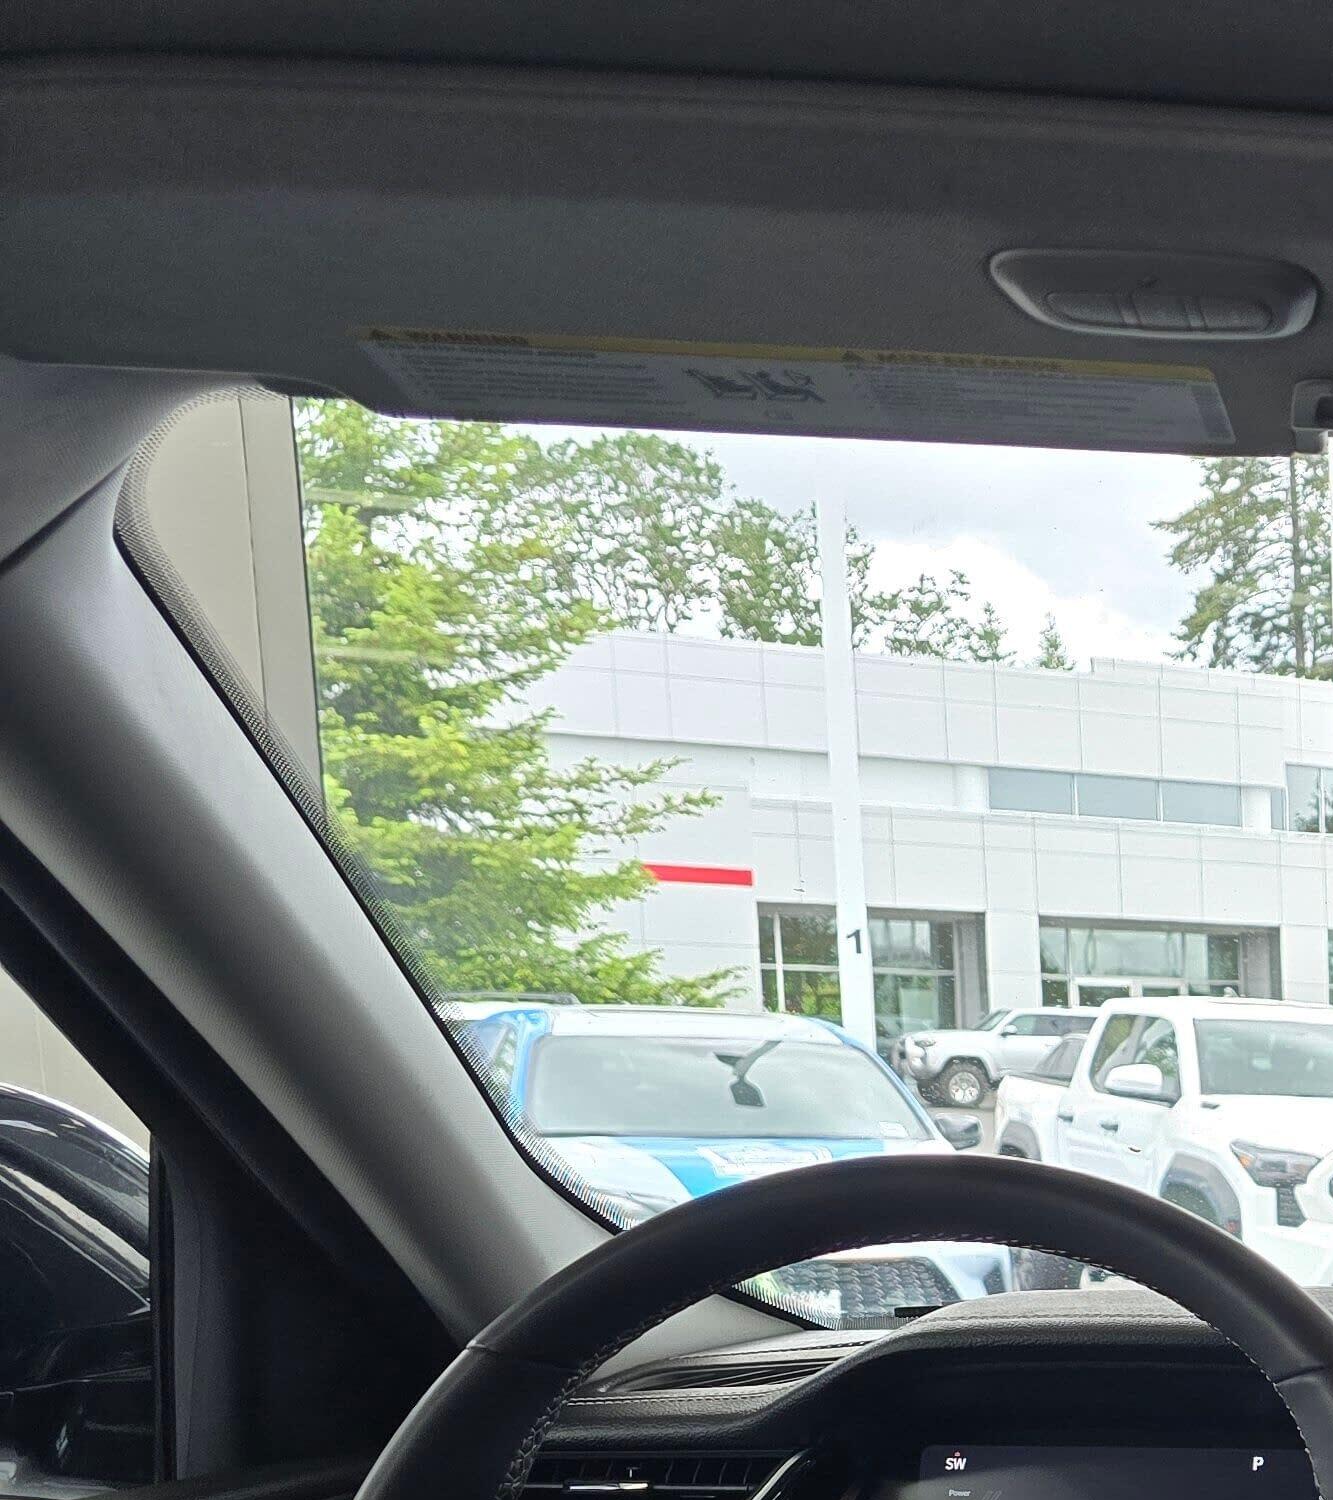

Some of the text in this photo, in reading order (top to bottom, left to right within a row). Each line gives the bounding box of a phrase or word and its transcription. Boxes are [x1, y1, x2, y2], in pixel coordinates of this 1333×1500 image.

[847, 929, 861, 954] 1
[945, 1458, 966, 1470] SW
[1252, 1457, 1264, 1471] P
[948, 1489, 971, 1497] Power
